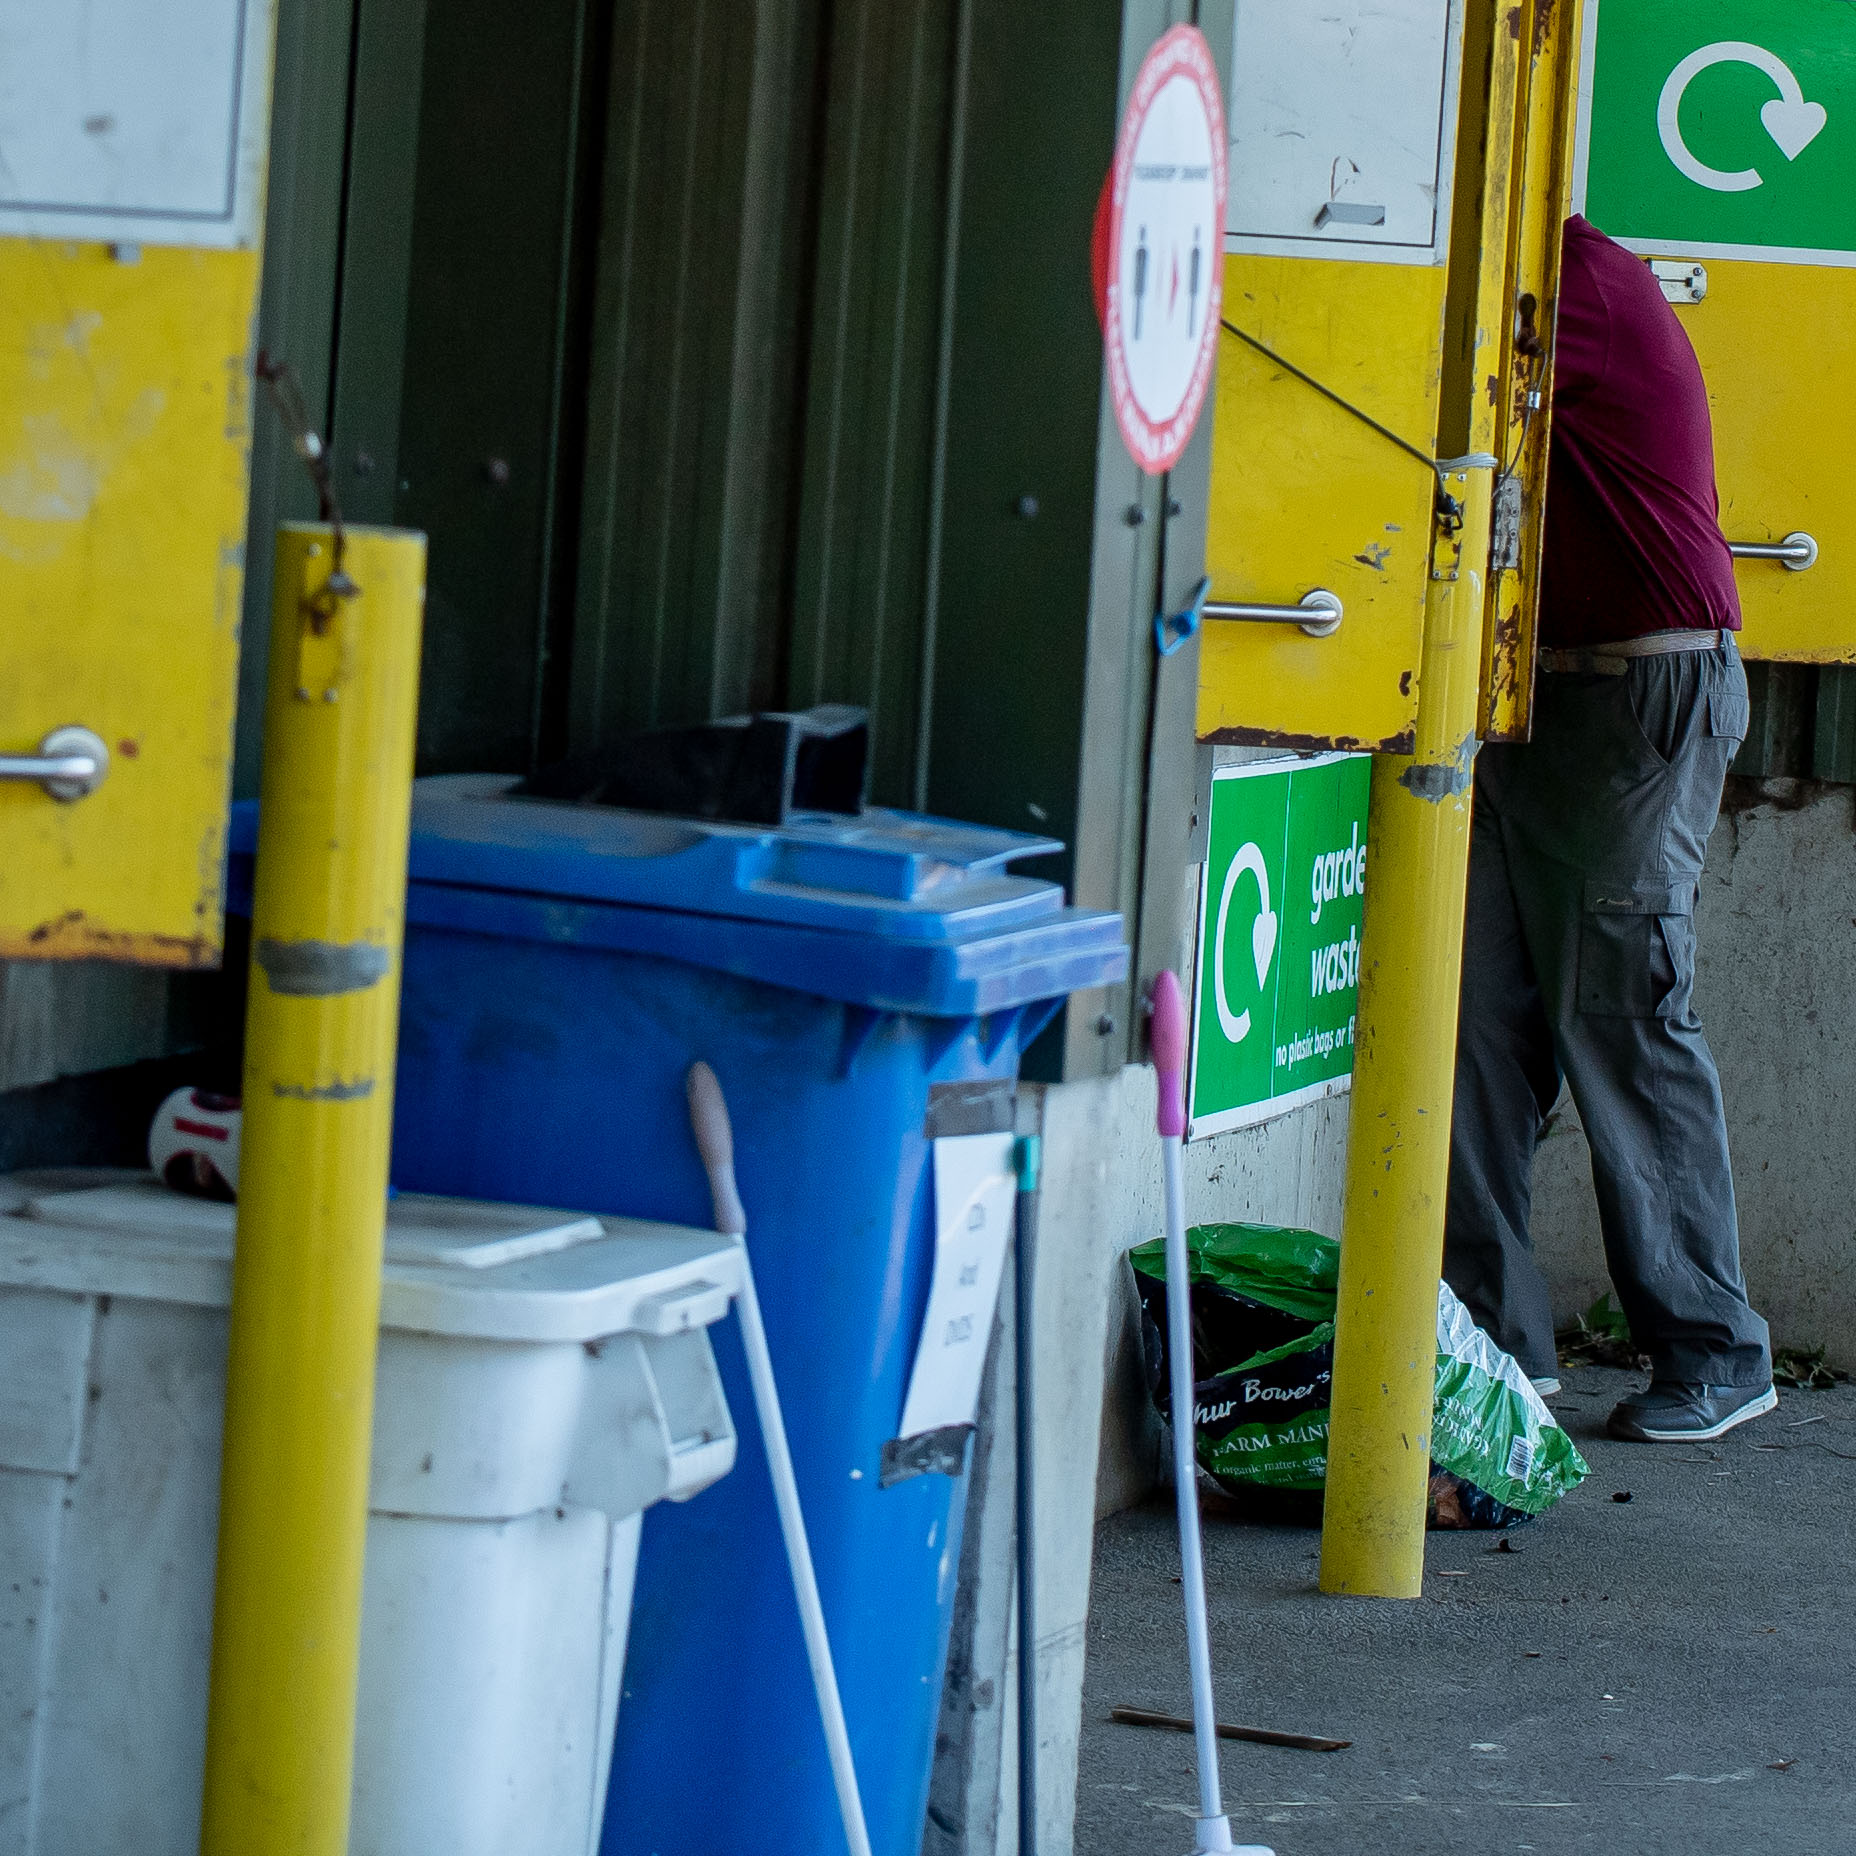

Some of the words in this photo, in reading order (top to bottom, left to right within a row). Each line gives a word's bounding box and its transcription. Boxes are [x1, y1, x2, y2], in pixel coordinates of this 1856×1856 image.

[1310, 820, 1368, 926] garde
[1274, 1044, 1288, 1068] no
[1288, 1027, 1314, 1072] plastic
[1313, 1024, 1335, 1060] bags
[1335, 1024, 1347, 1043] or
[1194, 1400, 1238, 1425] hur
[1240, 1370, 1332, 1404] Bower's
